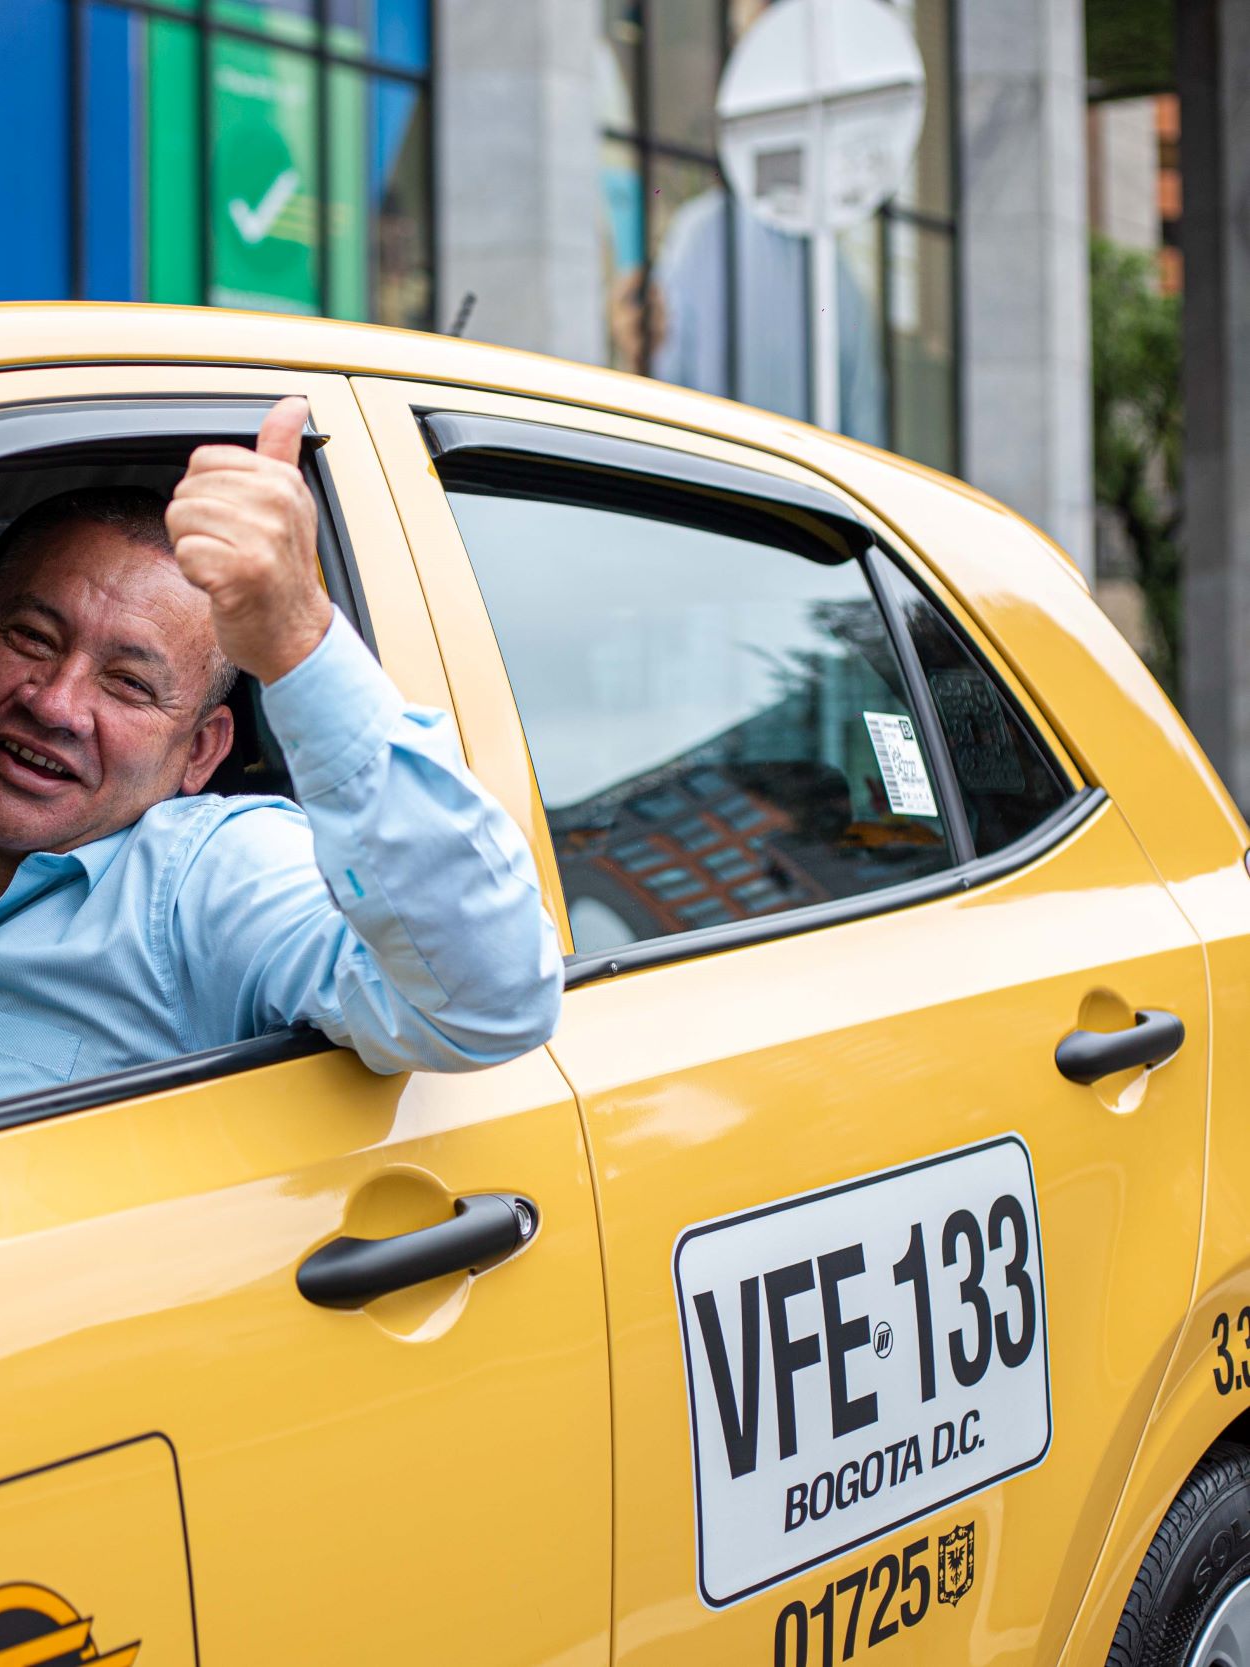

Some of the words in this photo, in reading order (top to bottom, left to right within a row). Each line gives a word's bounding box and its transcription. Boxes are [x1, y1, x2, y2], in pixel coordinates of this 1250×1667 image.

[692, 1242, 879, 1480] VFE
[892, 1194, 1037, 1404] 133
[784, 1433, 924, 1534] BOGOTA
[931, 1409, 986, 1469] D.C.
[773, 1535, 931, 1667] 01725
[1193, 1509, 1250, 1595] SOL
